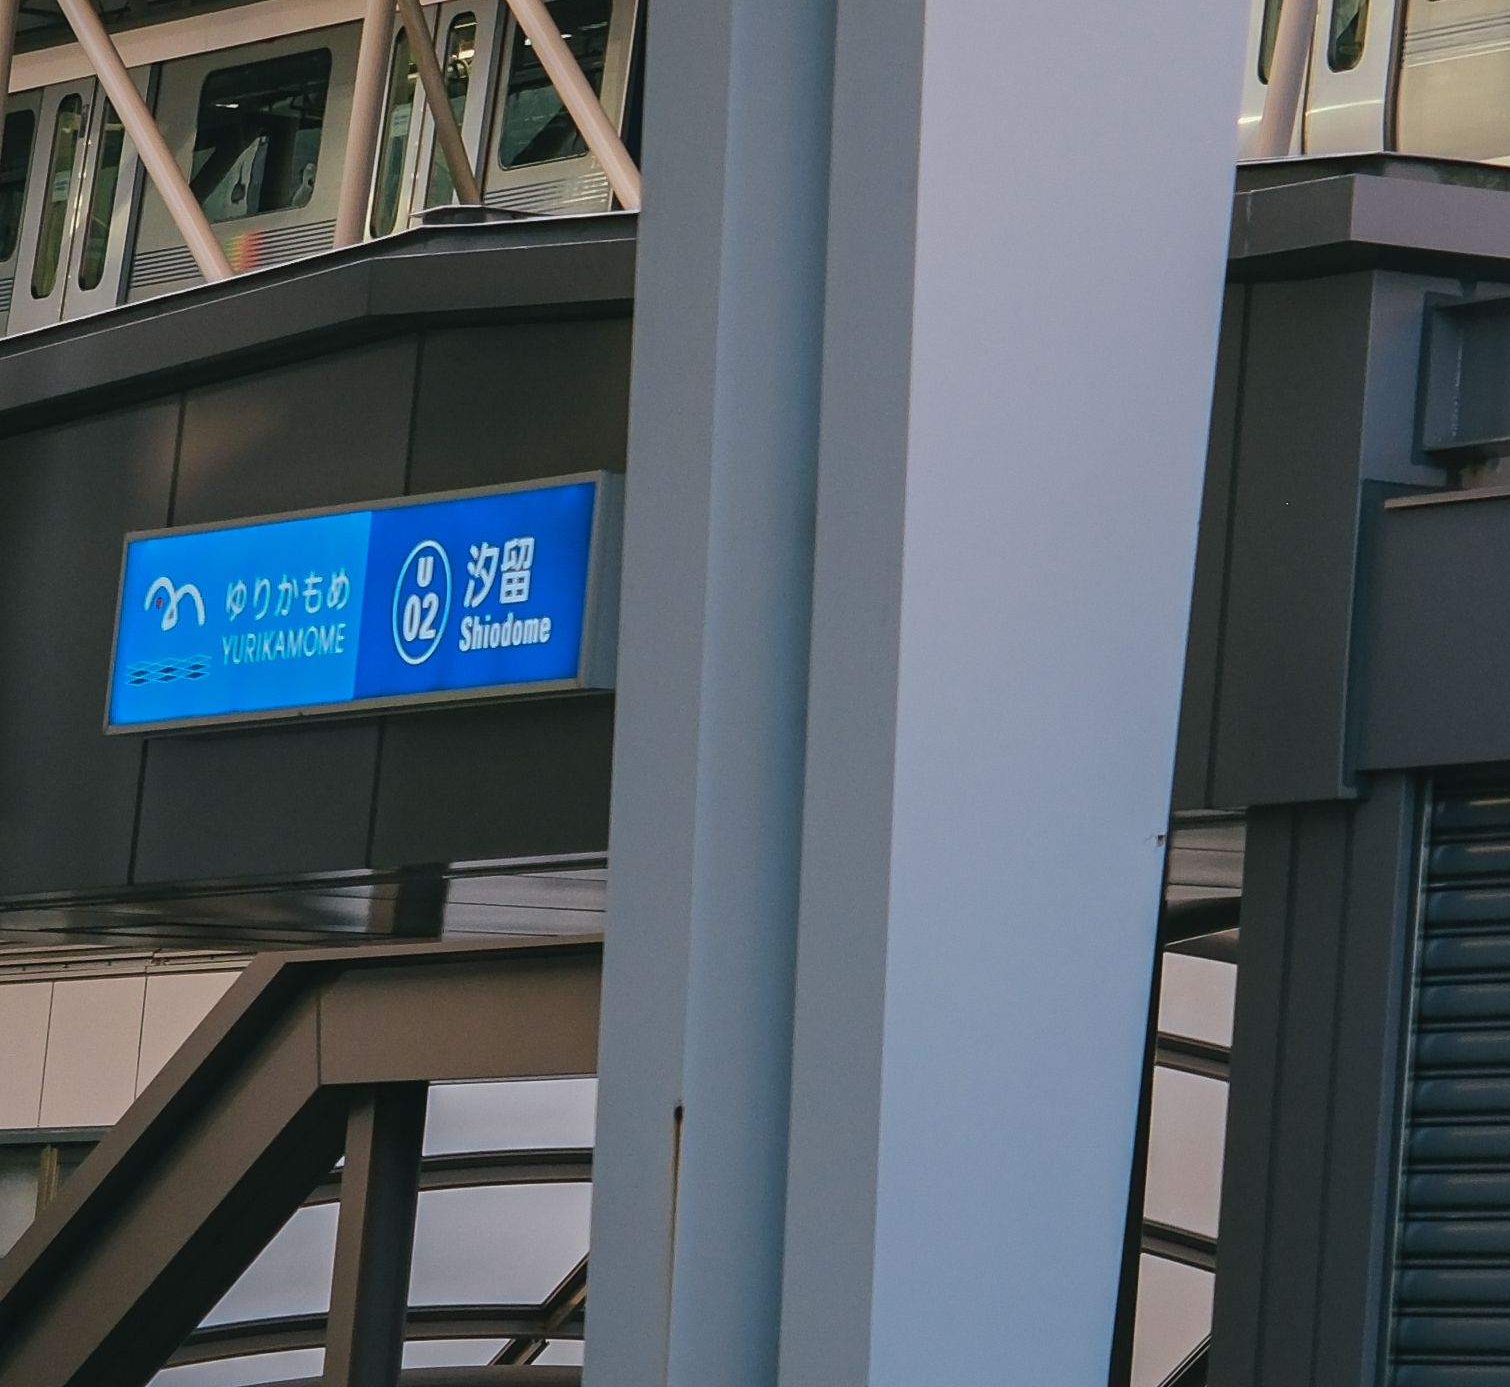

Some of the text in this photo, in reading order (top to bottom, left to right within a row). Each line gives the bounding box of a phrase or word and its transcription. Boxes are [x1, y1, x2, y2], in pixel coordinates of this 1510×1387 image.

[225, 567, 351, 622] ゆりかもめ
[416, 557, 433, 588] U
[464, 536, 534, 608] 汐留
[402, 593, 439, 643] 02
[458, 613, 552, 653] Shiodome
[222, 622, 346, 666] YURIKAMOME
